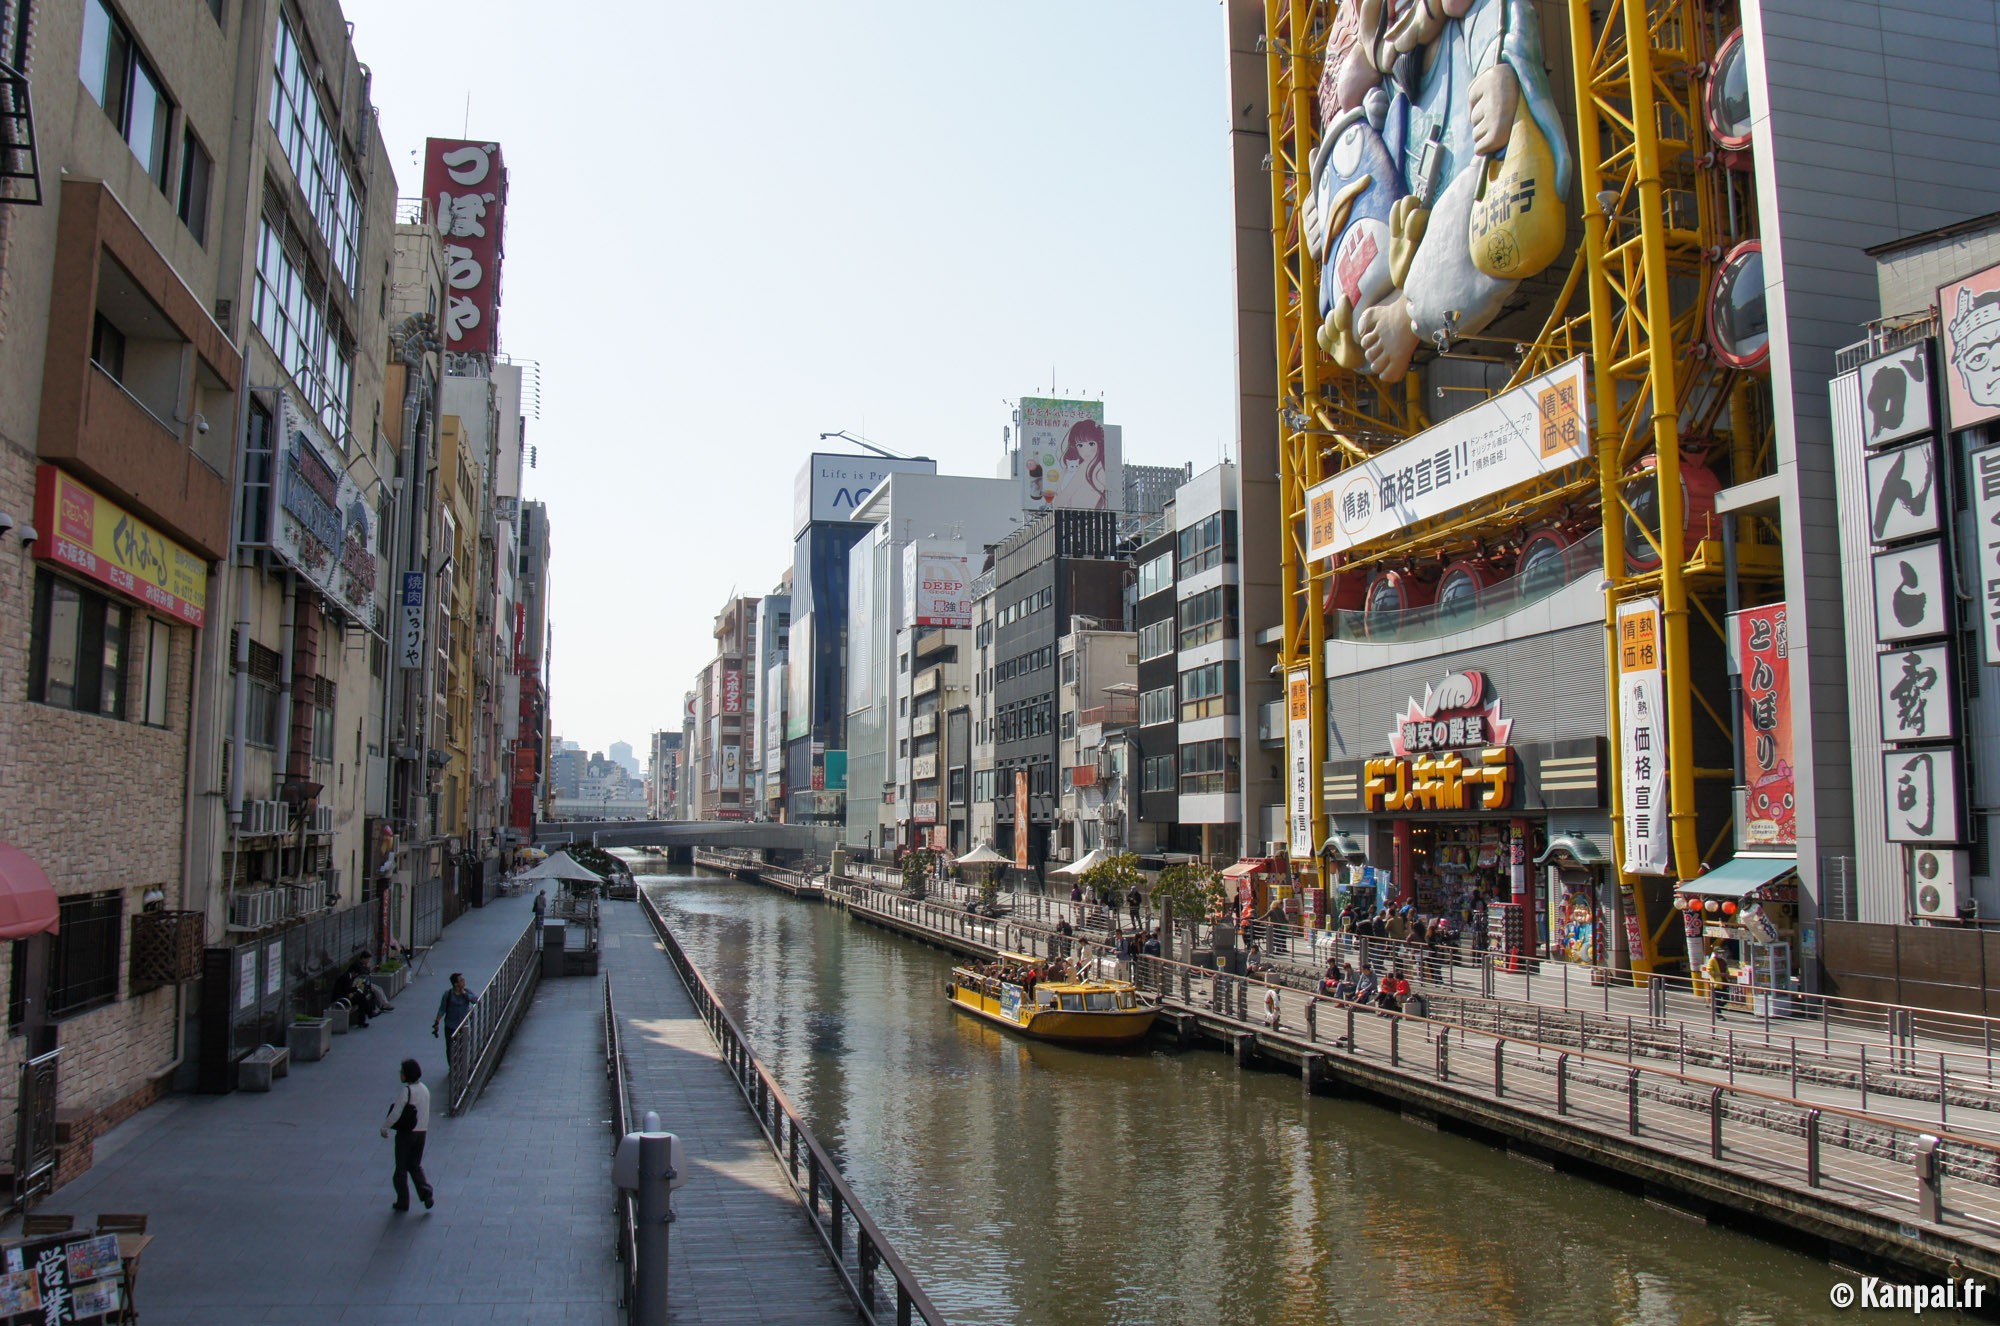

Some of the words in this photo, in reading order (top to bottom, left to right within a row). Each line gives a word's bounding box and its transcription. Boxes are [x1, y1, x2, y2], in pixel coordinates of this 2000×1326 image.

[1543, 384, 1574, 419] 情熱
[1544, 417, 1576, 451] 価格
[822, 469, 847, 479] Life
[854, 471, 863, 479] is
[57, 538, 97, 573] 大阪名物
[407, 575, 423, 605] 焼肉
[922, 581, 963, 591] DEEP
[405, 606, 421, 666] いろりや
[1624, 616, 1653, 640] 情熱
[1624, 644, 1654, 668] 価格
[726, 671, 739, 712] スポタカ
[1749, 617, 1778, 772] とんぼり
[1403, 716, 1483, 750] 激安の殿堂
